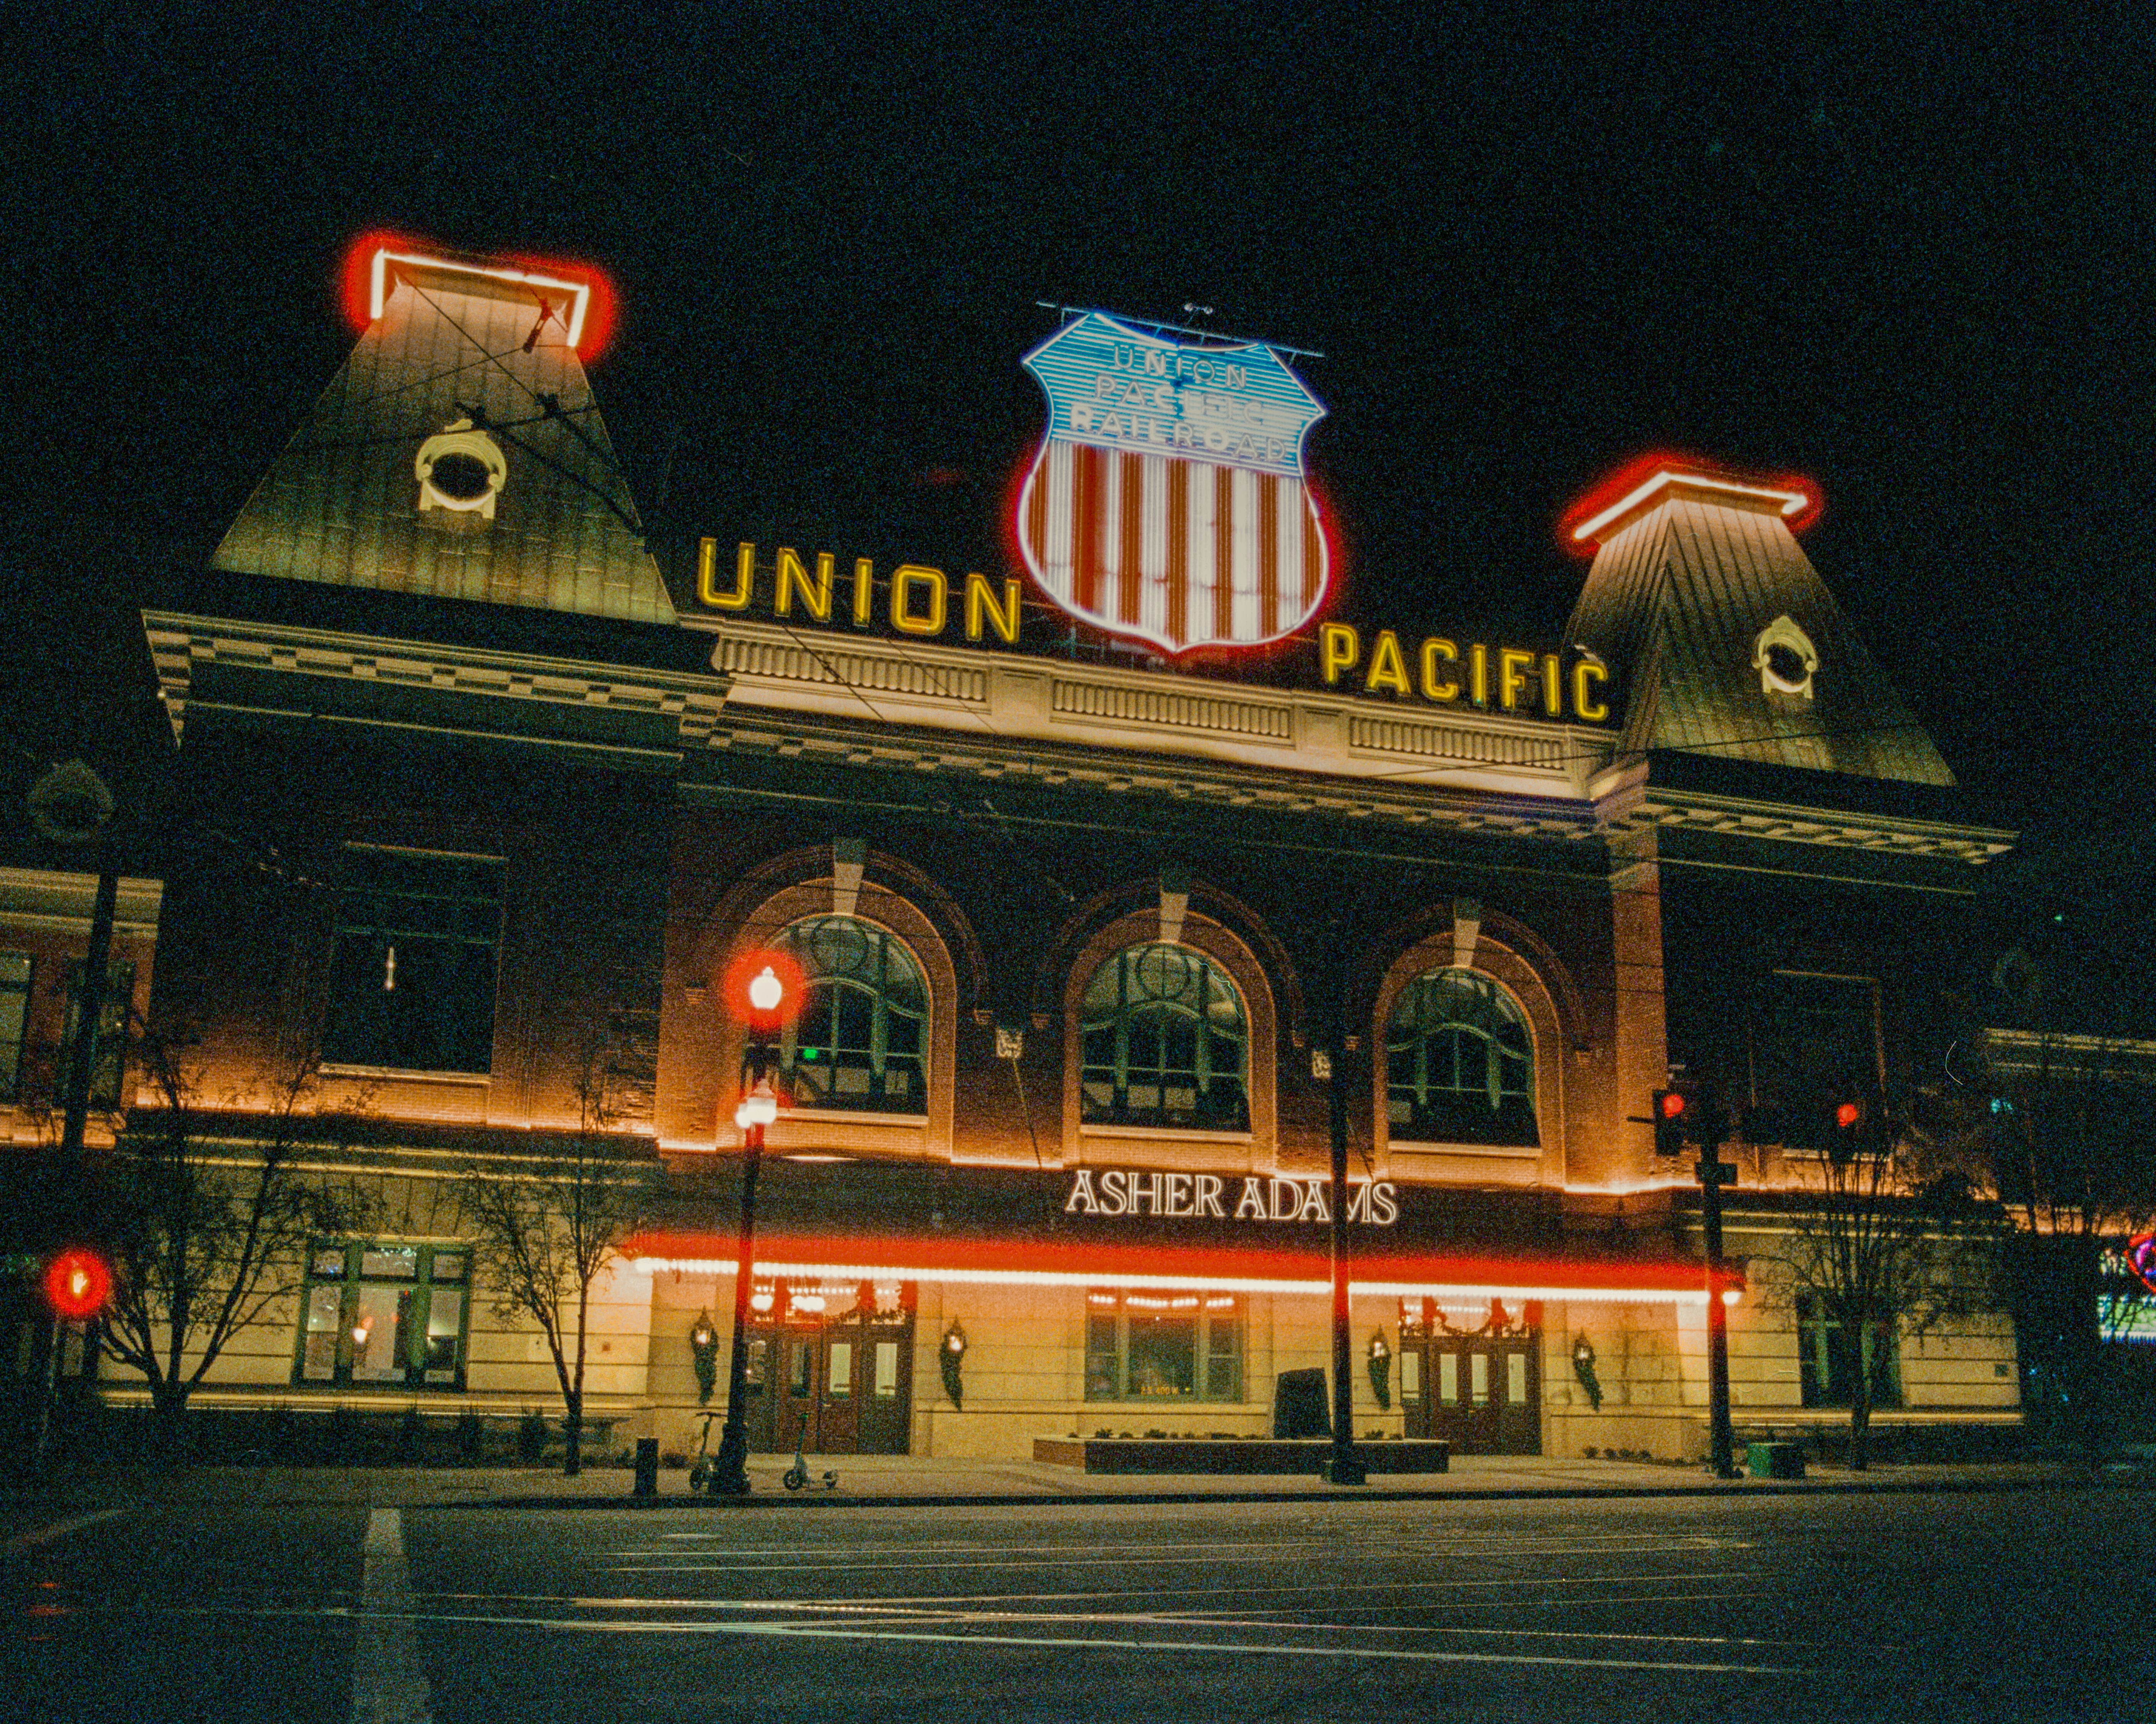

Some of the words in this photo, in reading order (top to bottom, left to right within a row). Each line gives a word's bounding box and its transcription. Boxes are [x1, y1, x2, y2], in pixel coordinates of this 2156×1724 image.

[1114, 345, 1246, 388] UNION
[1095, 373, 1263, 425] PACIFIC
[1070, 403, 1287, 461] RAILROAD
[697, 537, 1021, 643] UNION
[1319, 622, 1608, 721] PACIFIC
[1065, 1170, 1225, 1217] ASHER
